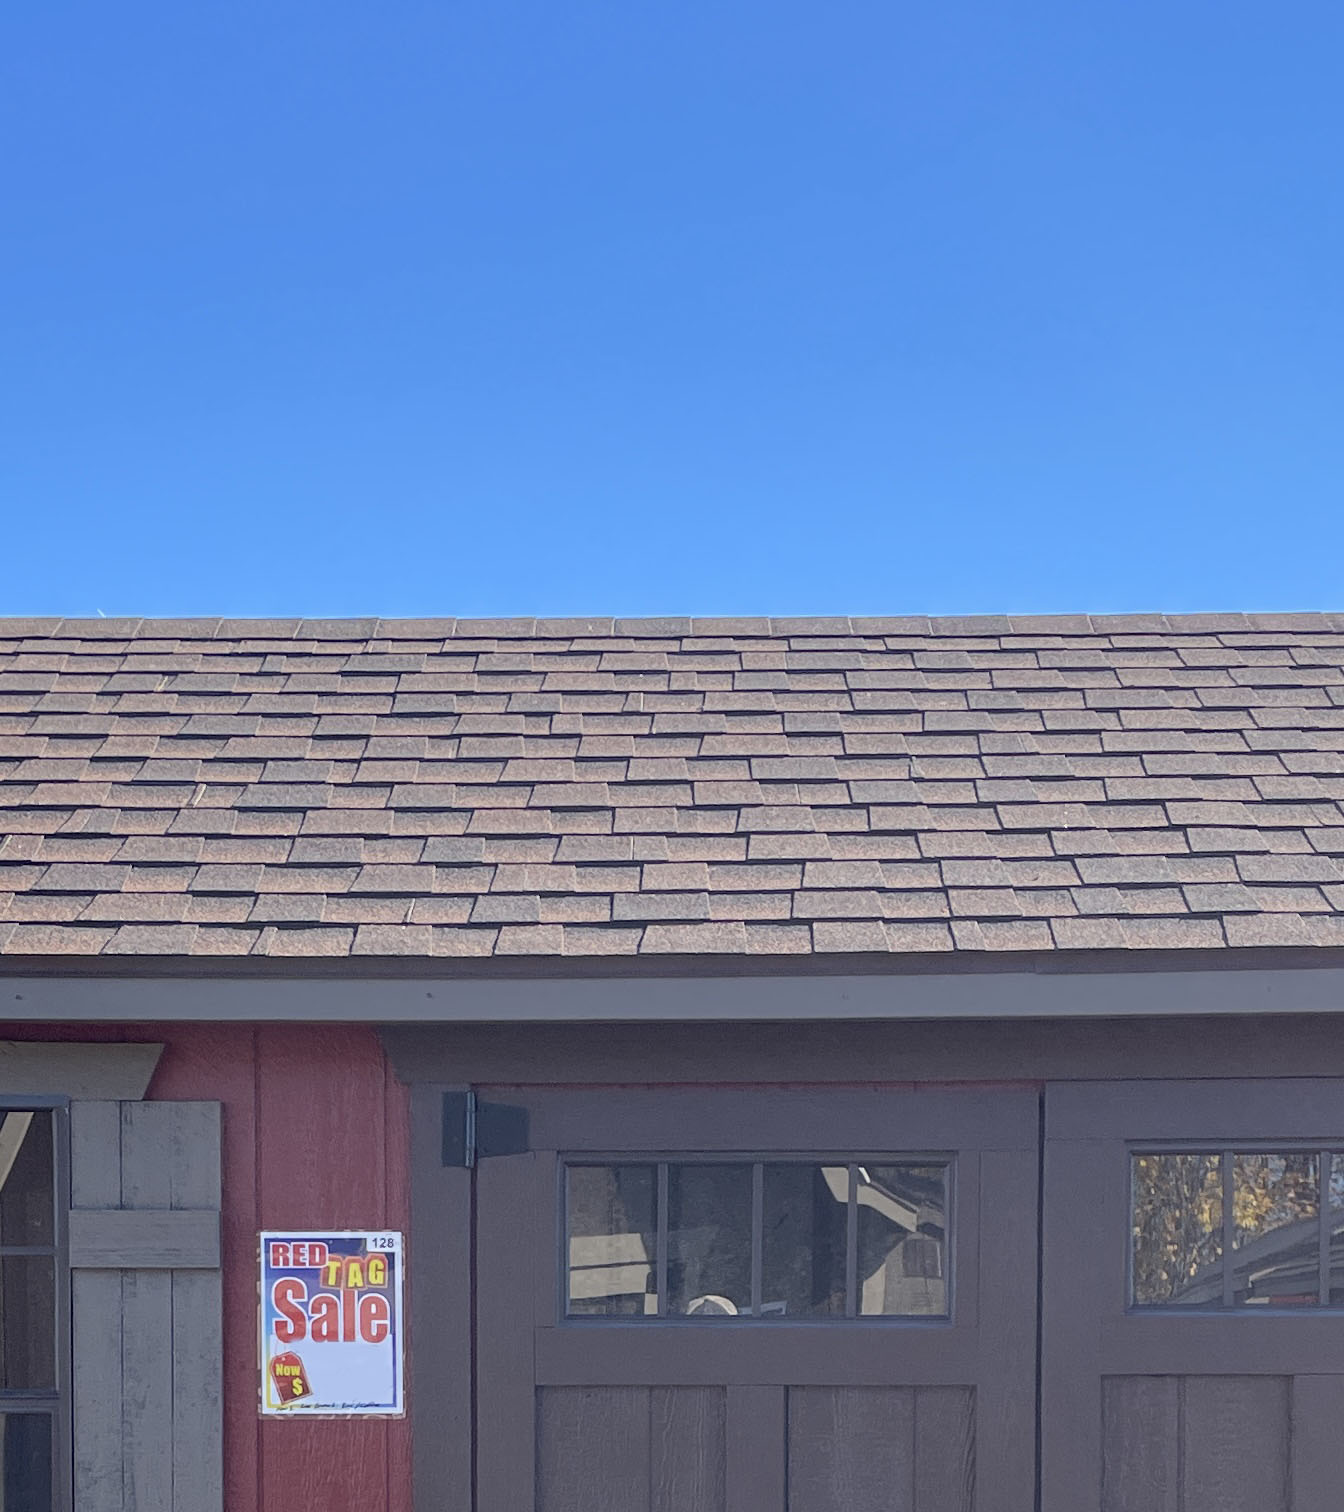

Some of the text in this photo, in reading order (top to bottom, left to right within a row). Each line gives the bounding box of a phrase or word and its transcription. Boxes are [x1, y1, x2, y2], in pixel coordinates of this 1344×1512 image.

[372, 1237, 395, 1248] 128
[271, 1243, 385, 1288] RED TAG
[273, 1278, 389, 1343] Sale
[292, 1377, 304, 1396] $
